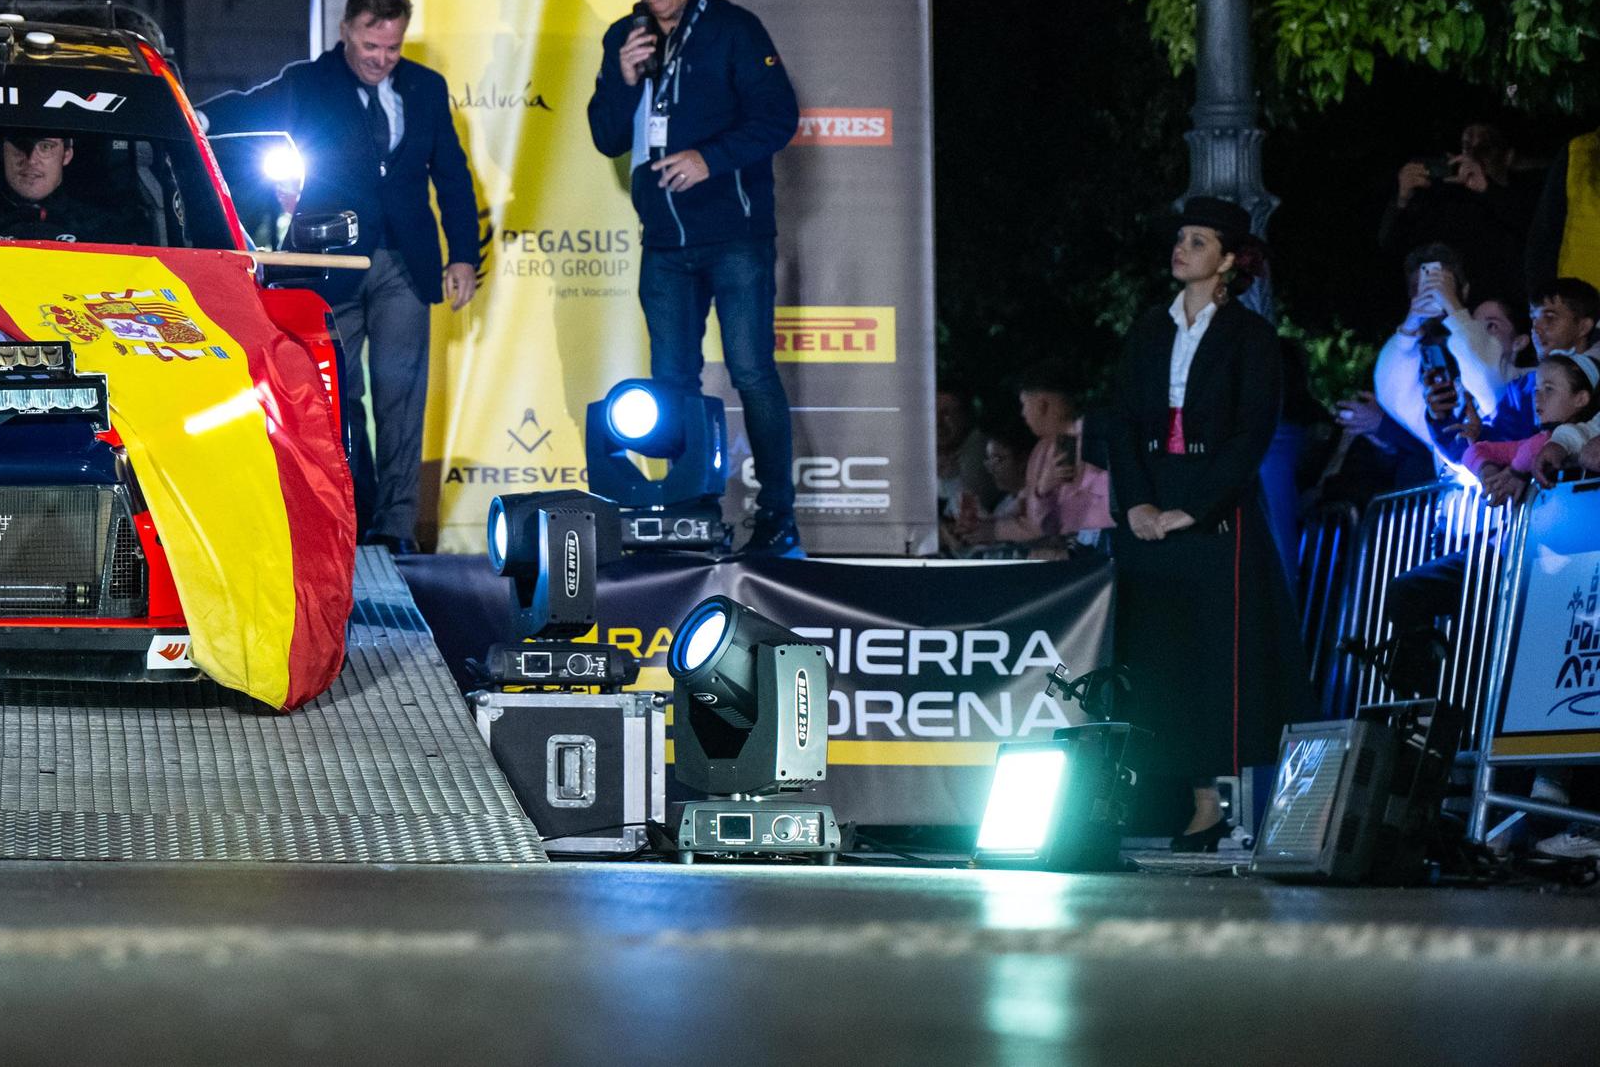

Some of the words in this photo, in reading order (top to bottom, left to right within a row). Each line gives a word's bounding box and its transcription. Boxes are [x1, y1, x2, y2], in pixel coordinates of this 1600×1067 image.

[451, 82, 555, 113] ndalucía
[799, 117, 886, 137] TYRES
[502, 230, 630, 254] PEGASUS
[502, 259, 555, 277] AERO
[562, 259, 630, 277] GROUP
[567, 538, 576, 569] BEAM
[567, 570, 575, 591] 230
[798, 678, 808, 716] BEAM
[798, 716, 808, 741] 230
